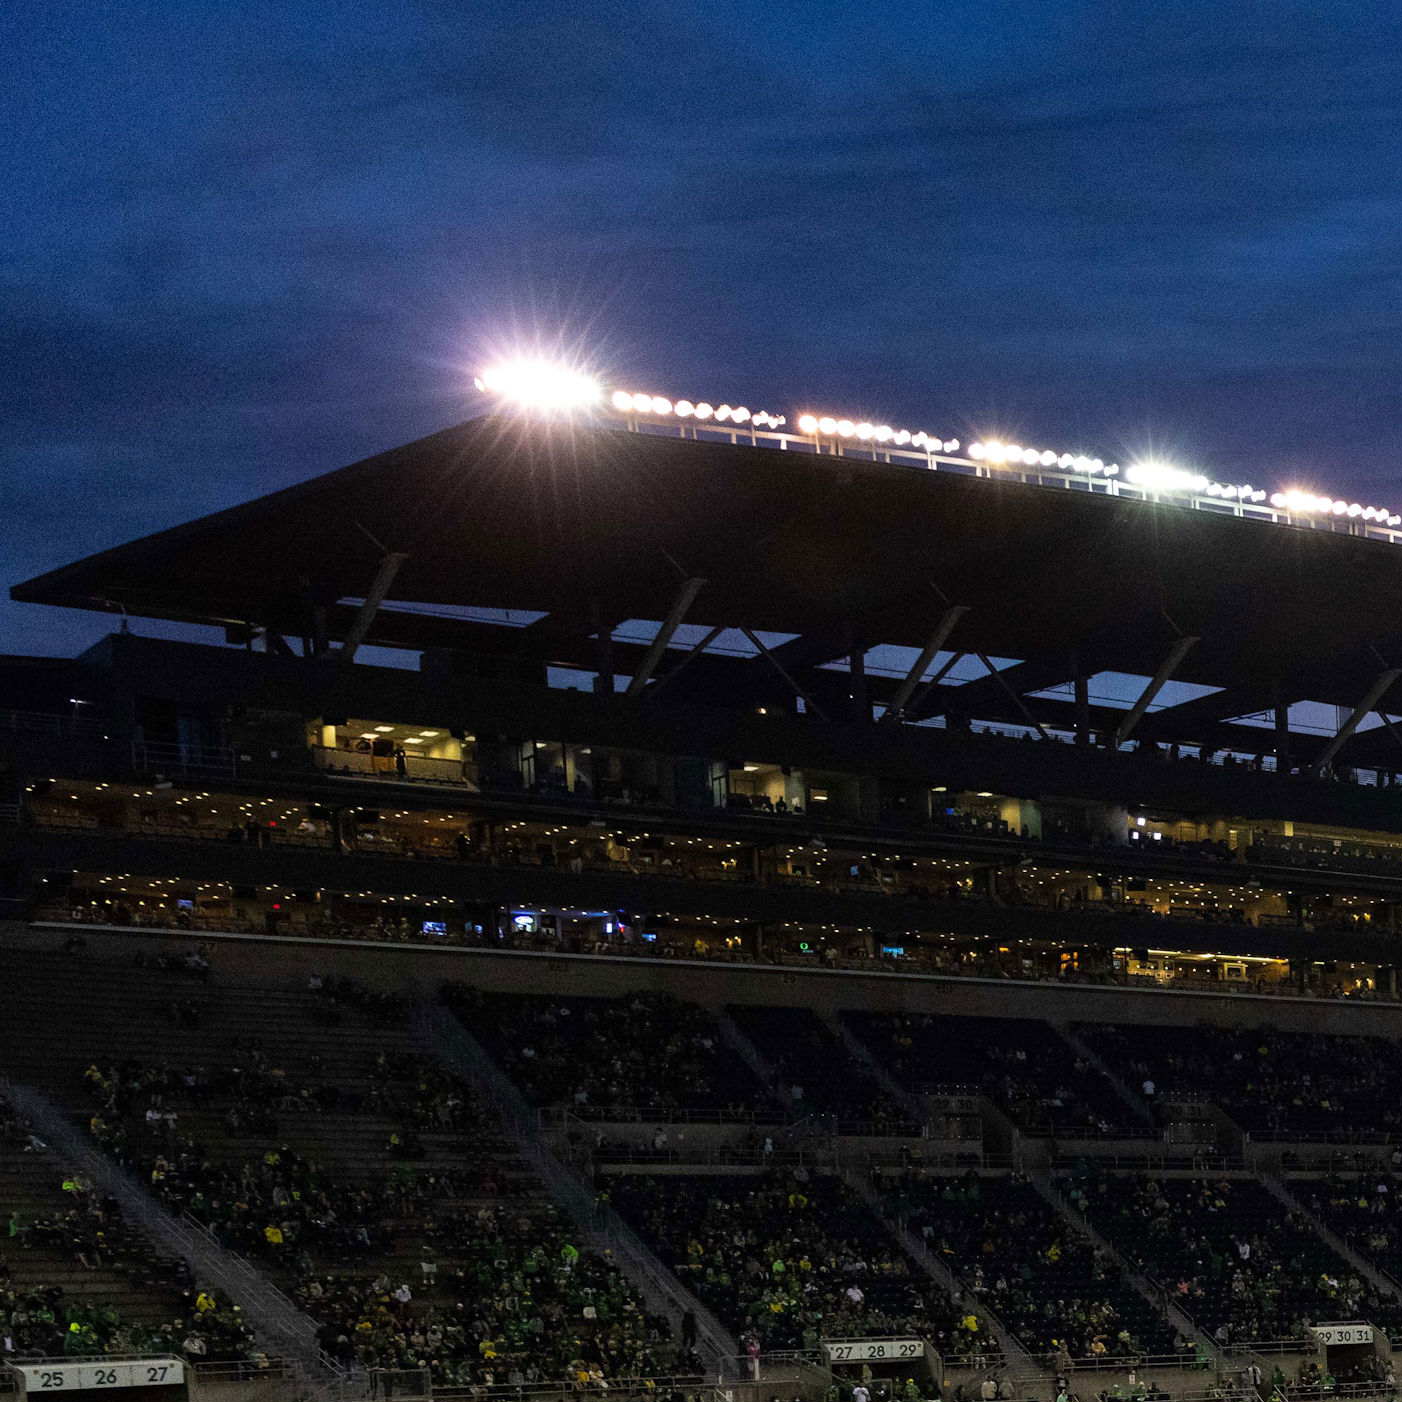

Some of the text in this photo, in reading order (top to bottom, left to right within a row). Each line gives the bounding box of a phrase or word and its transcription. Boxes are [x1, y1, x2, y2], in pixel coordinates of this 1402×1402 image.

[1336, 1331, 1352, 1342] 30
[1355, 1330, 1370, 1341] 31
[835, 1343, 917, 1359] 27 28 29
[41, 1366, 168, 1388] 25 26 27
